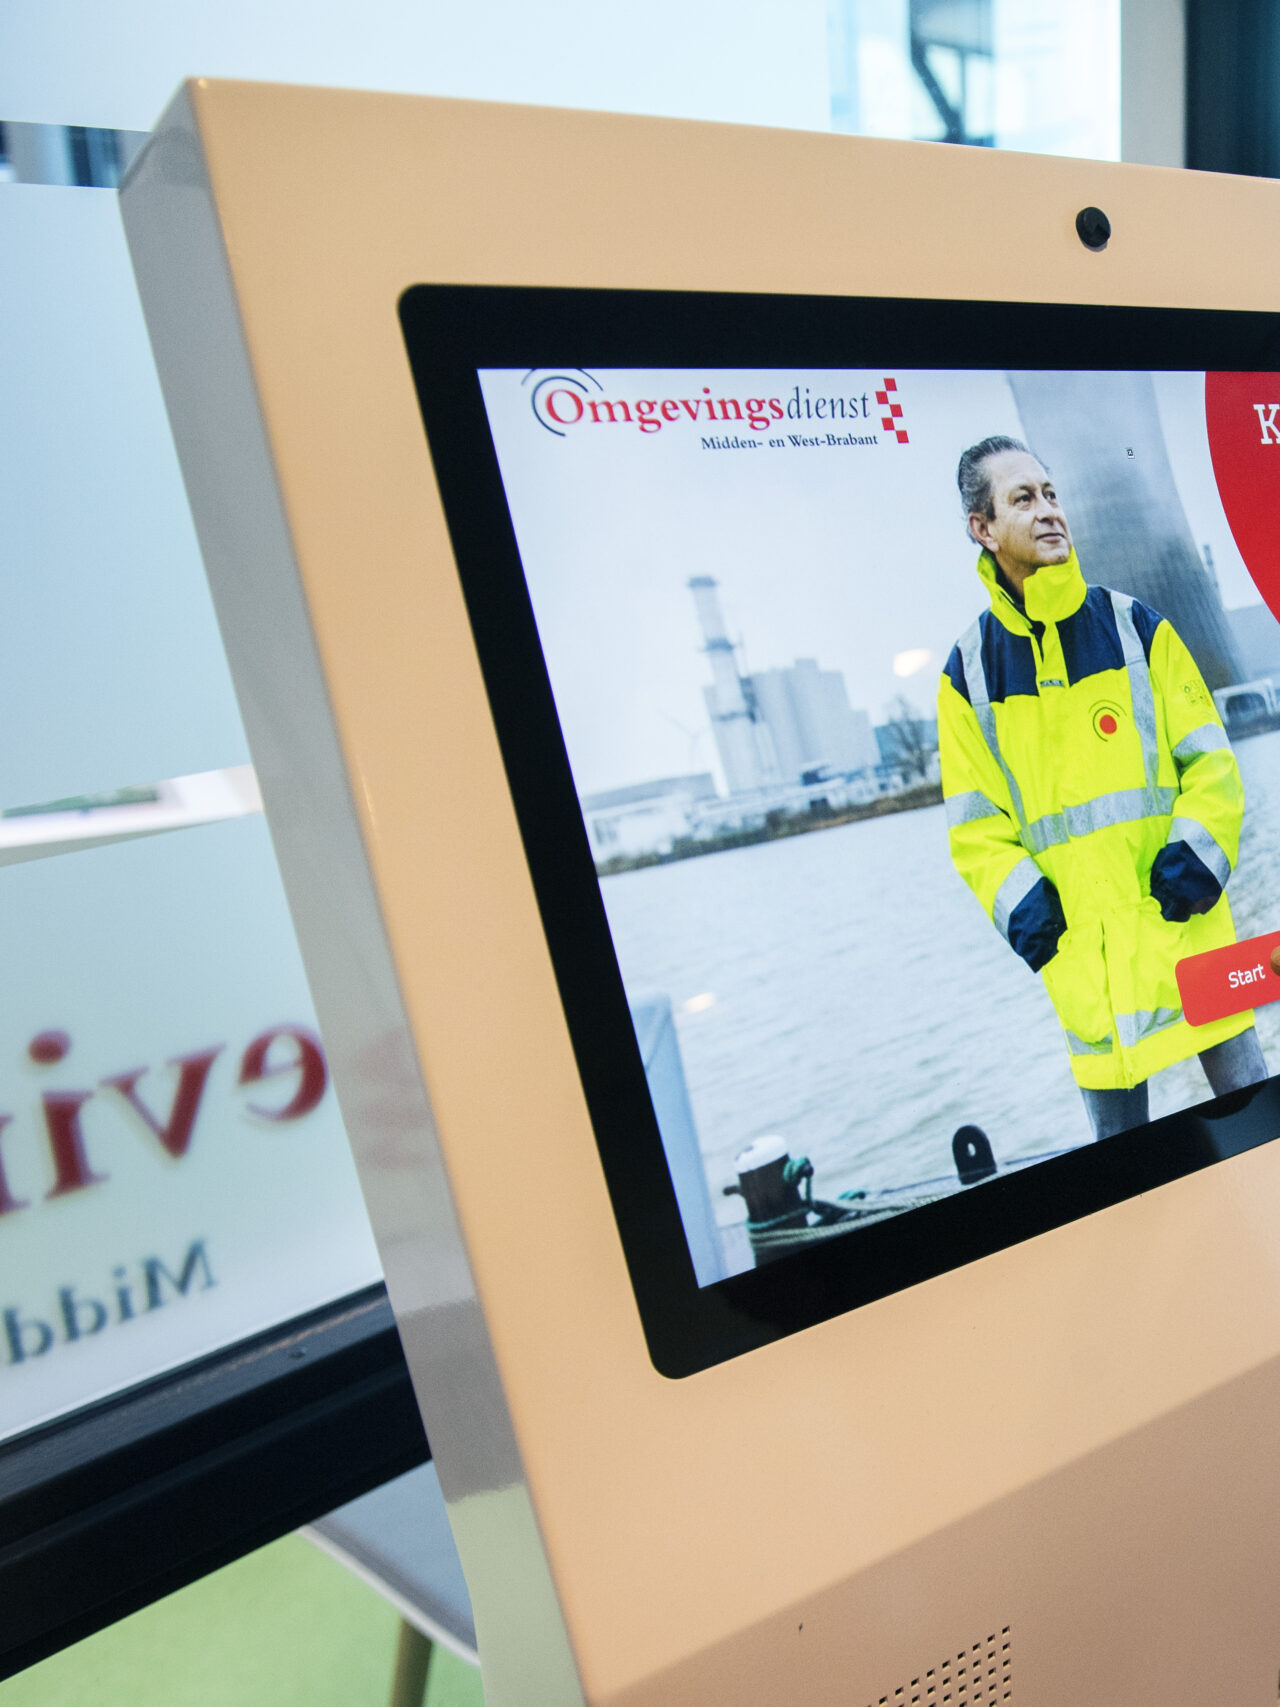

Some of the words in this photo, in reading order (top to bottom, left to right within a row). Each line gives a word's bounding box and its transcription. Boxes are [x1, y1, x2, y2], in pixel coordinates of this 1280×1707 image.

[546, 387, 871, 433] Omgevingsdienst
[701, 436, 764, 450] Midden-
[768, 438, 785, 448] en
[787, 433, 879, 448] West-Brabant
[1228, 963, 1266, 989] Start
